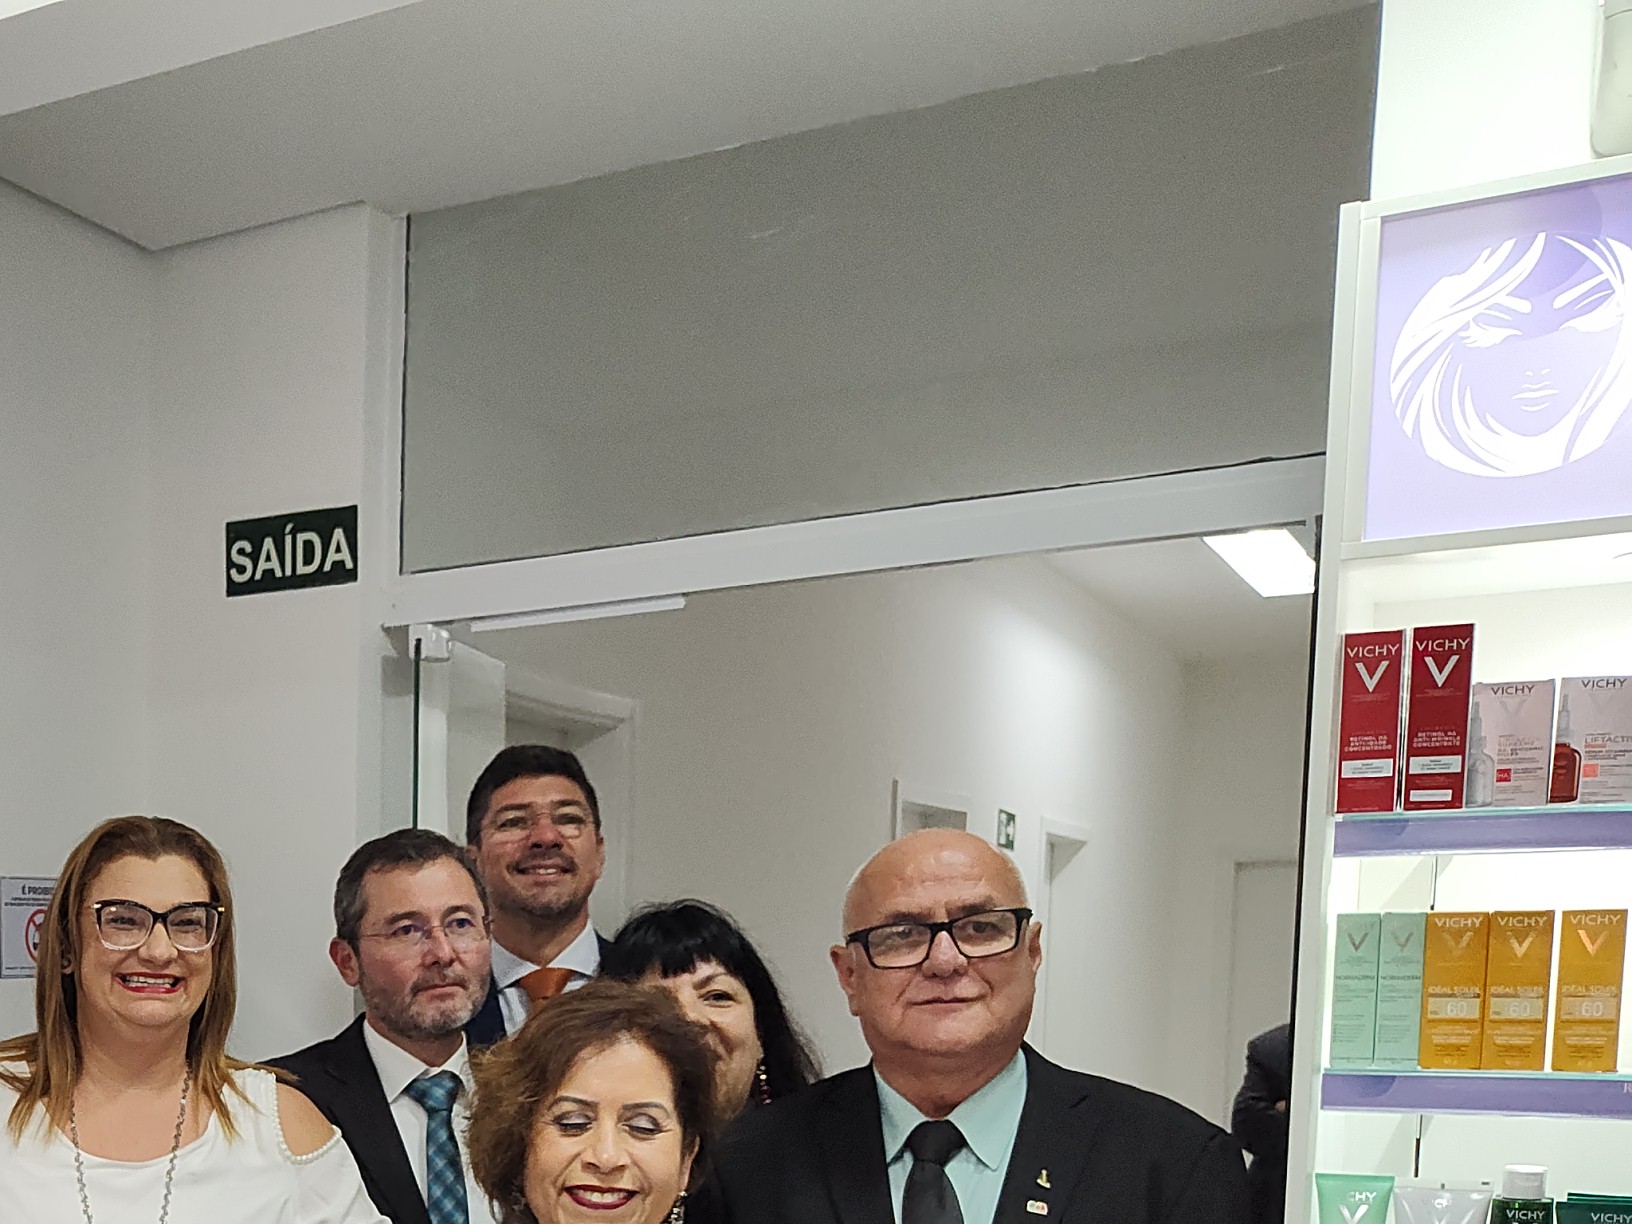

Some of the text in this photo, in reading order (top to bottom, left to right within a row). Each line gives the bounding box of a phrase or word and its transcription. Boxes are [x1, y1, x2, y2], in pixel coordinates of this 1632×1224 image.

[229, 523, 354, 583] SAÍDA
[1416, 638, 1470, 651] VICHY
[1347, 644, 1399, 657] VICHY
[1582, 679, 1627, 688] VICHY
[1491, 685, 1535, 695] VICHY
[1435, 917, 1483, 928] VICHY
[1497, 916, 1547, 927] VICHY
[1570, 914, 1621, 925] VICHY
[1447, 1001, 1467, 1016] 60
[1581, 1001, 1603, 1016] 60
[1506, 1209, 1545, 1220] VICHY
[1591, 1212, 1632, 1224] VICHY
